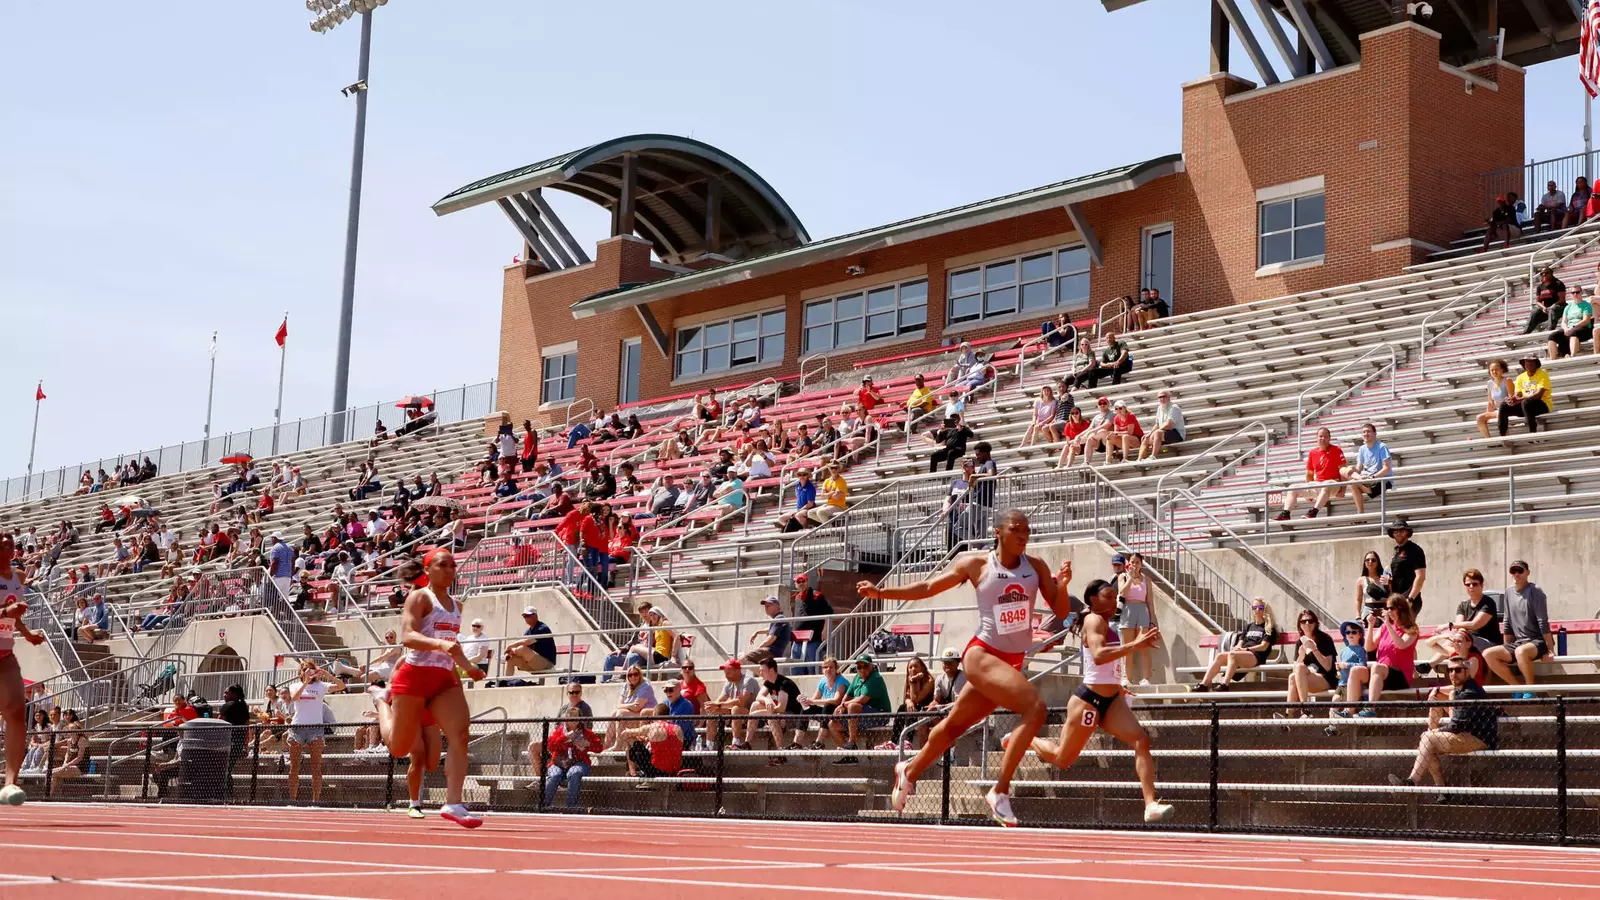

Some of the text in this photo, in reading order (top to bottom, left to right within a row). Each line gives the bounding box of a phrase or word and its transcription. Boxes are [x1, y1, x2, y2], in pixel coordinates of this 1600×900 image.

[1268, 493, 1281, 503] 209
[1000, 609, 1026, 623] 4849
[1084, 711, 1094, 725] 8
